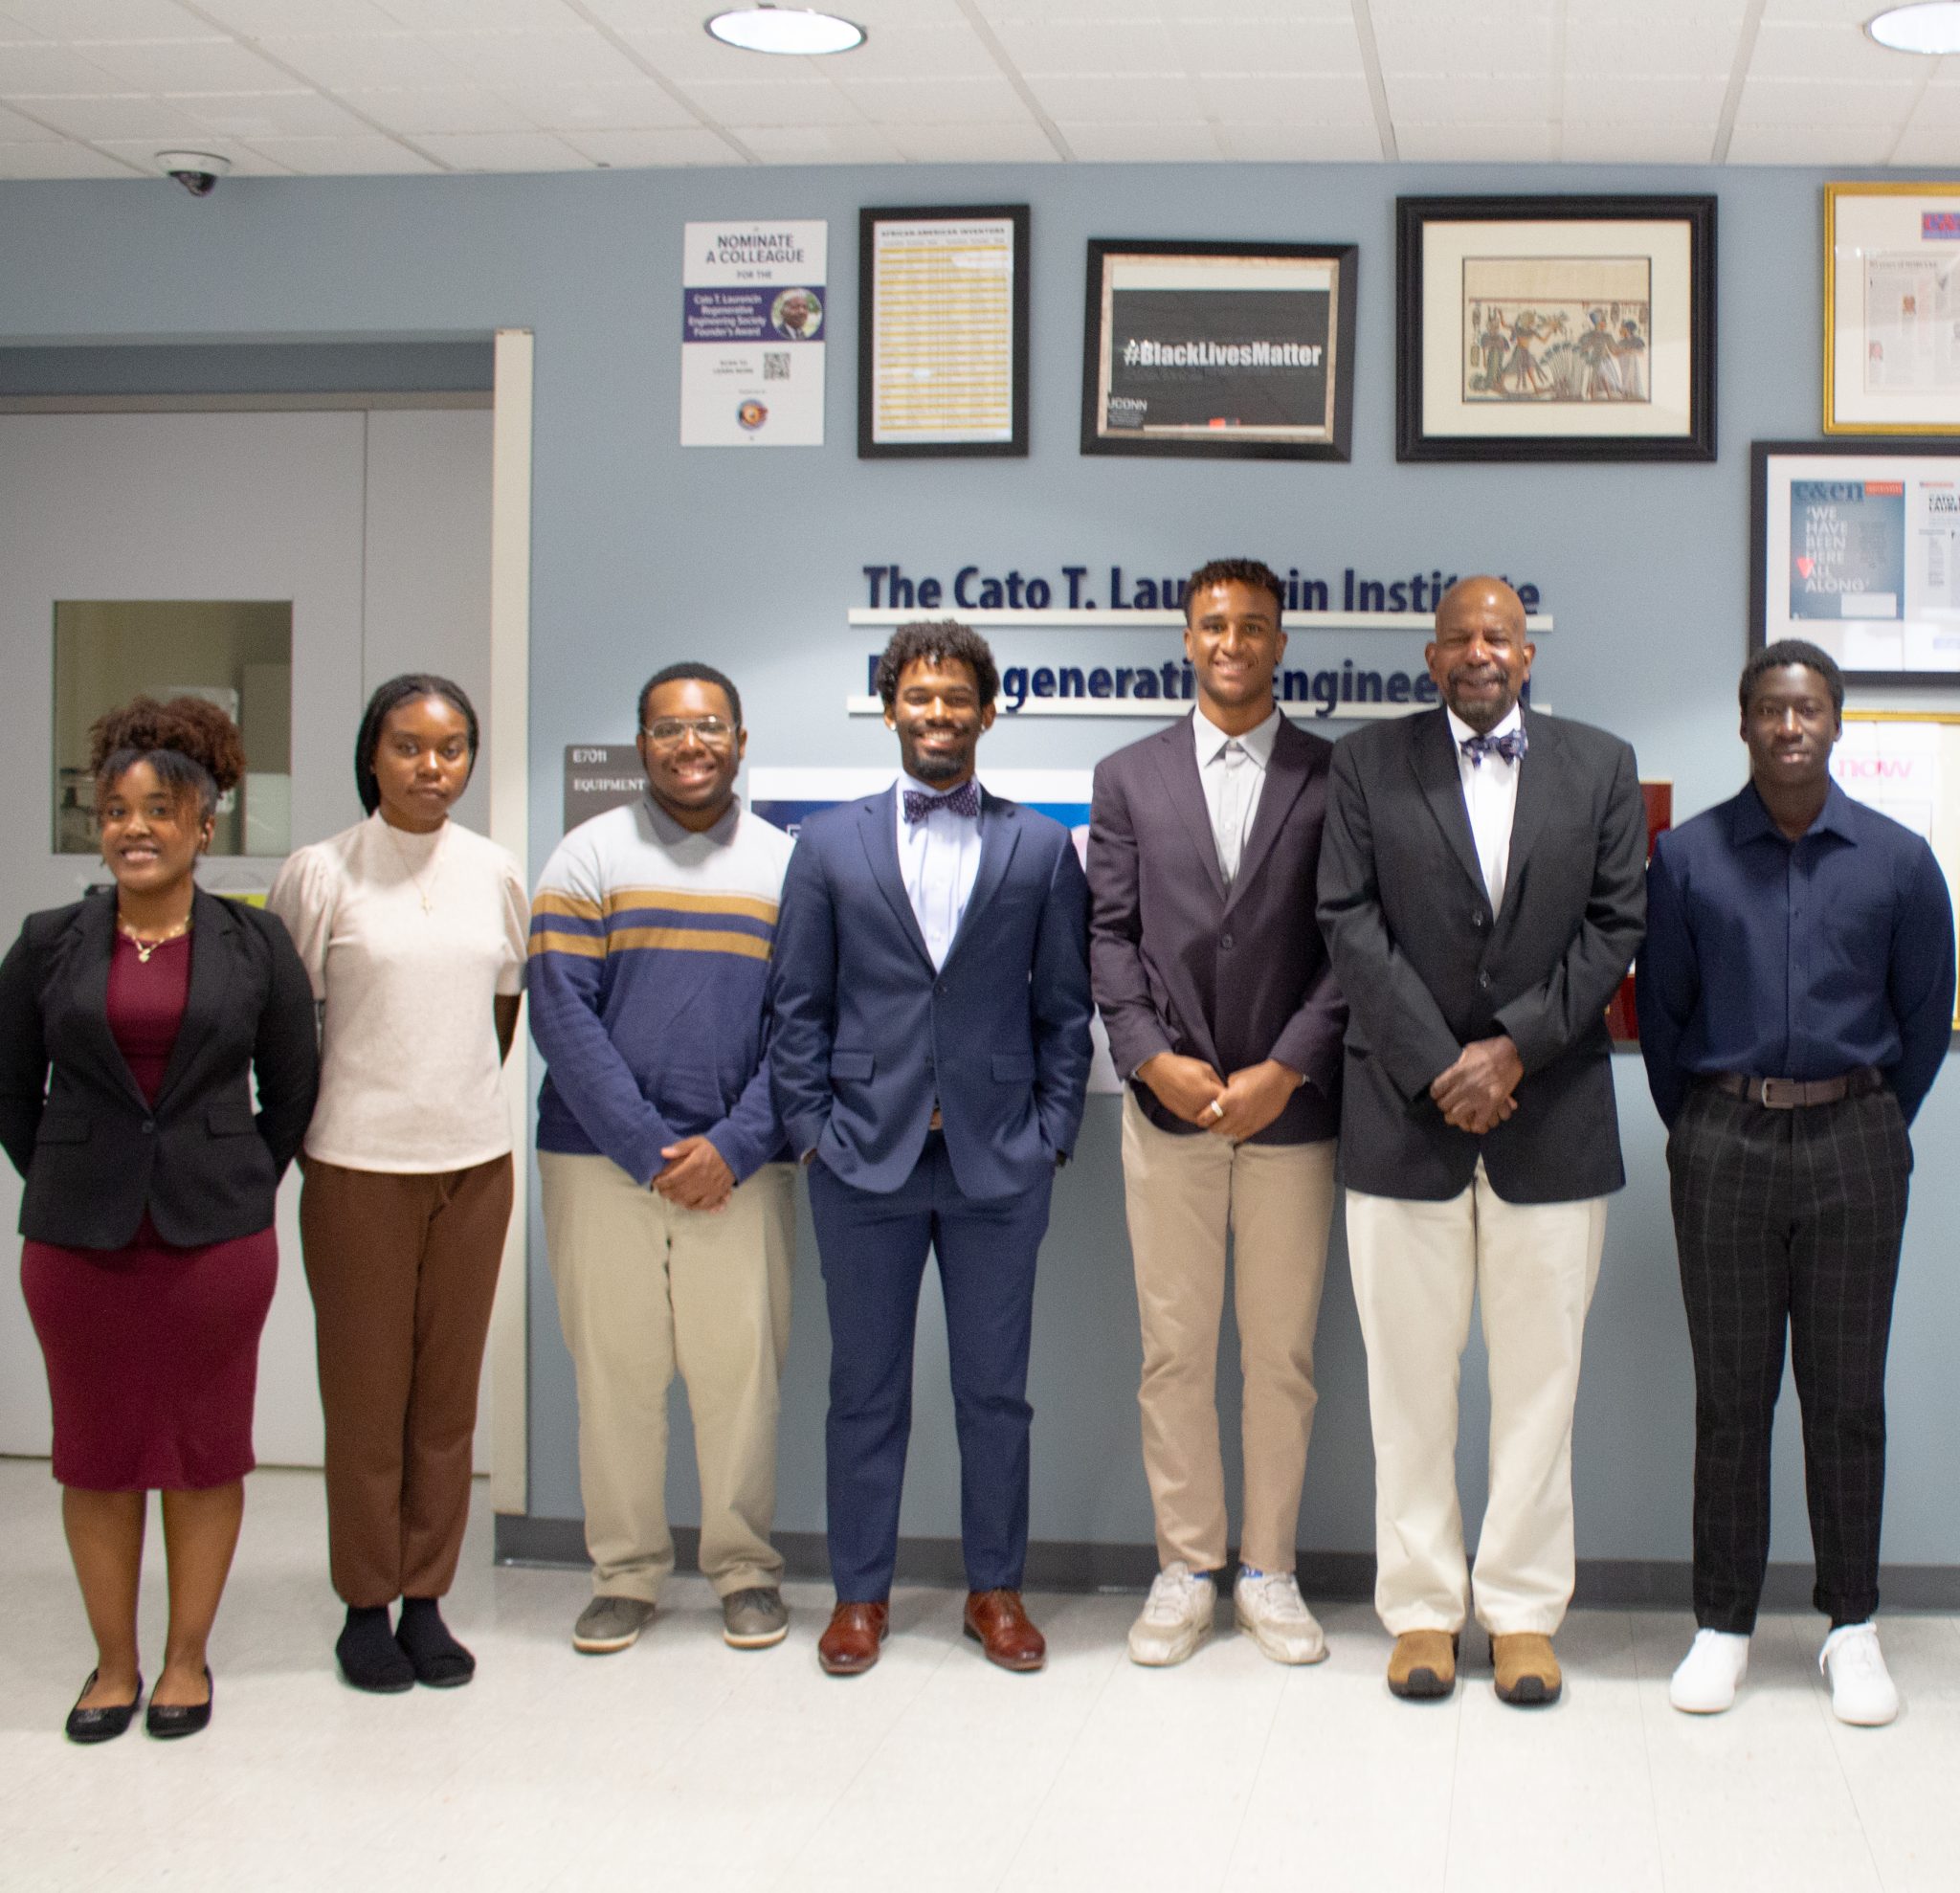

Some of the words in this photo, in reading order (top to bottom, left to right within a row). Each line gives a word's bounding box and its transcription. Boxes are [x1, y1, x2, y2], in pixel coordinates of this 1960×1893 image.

[717, 235, 794, 249] NOMINATE
[705, 251, 716, 263] A
[720, 249, 805, 263] COLLEAGUE
[737, 271, 754, 279] FOR
[756, 271, 772, 279] THE
[1124, 340, 1323, 367] #BlackLivesMatter
[863, 566, 942, 610] The
[954, 566, 1051, 610] Cato
[1061, 567, 1097, 610] T.
[1111, 567, 1328, 612] Lauin
[572, 749, 608, 764] E7011
[573, 779, 646, 792] EQUIPMENT
